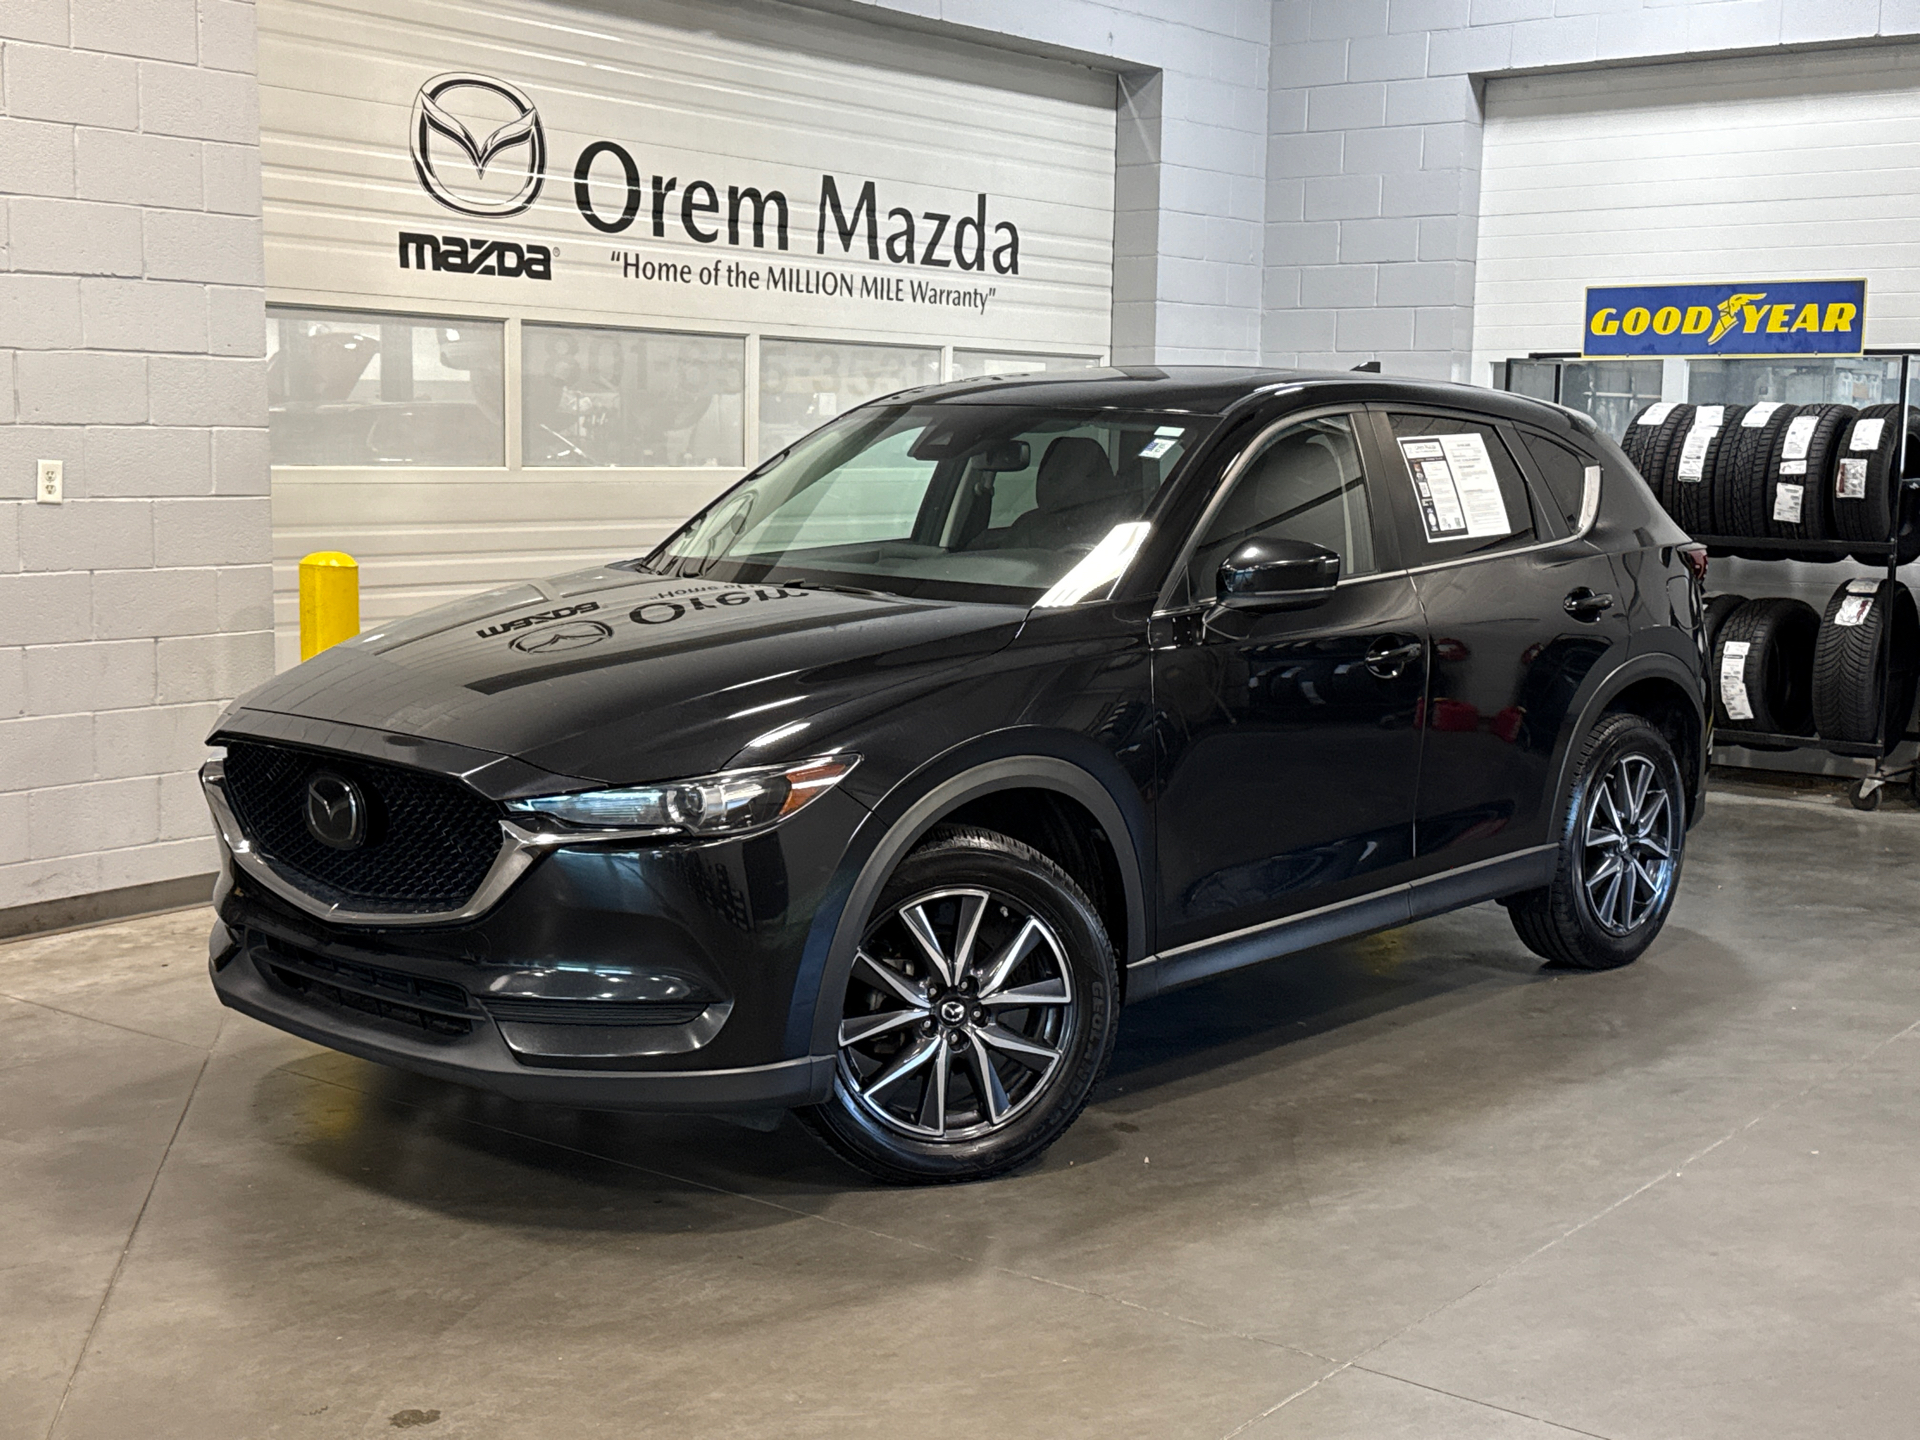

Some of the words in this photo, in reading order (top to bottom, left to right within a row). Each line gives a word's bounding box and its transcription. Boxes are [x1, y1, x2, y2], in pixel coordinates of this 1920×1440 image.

[574, 140, 789, 251] Orem
[817, 174, 1019, 275] Mazda
[611, 251, 692, 284] “Home
[699, 259, 722, 287] of
[726, 261, 760, 290] the
[766, 266, 854, 298] MILLION
[860, 275, 904, 302] MILE
